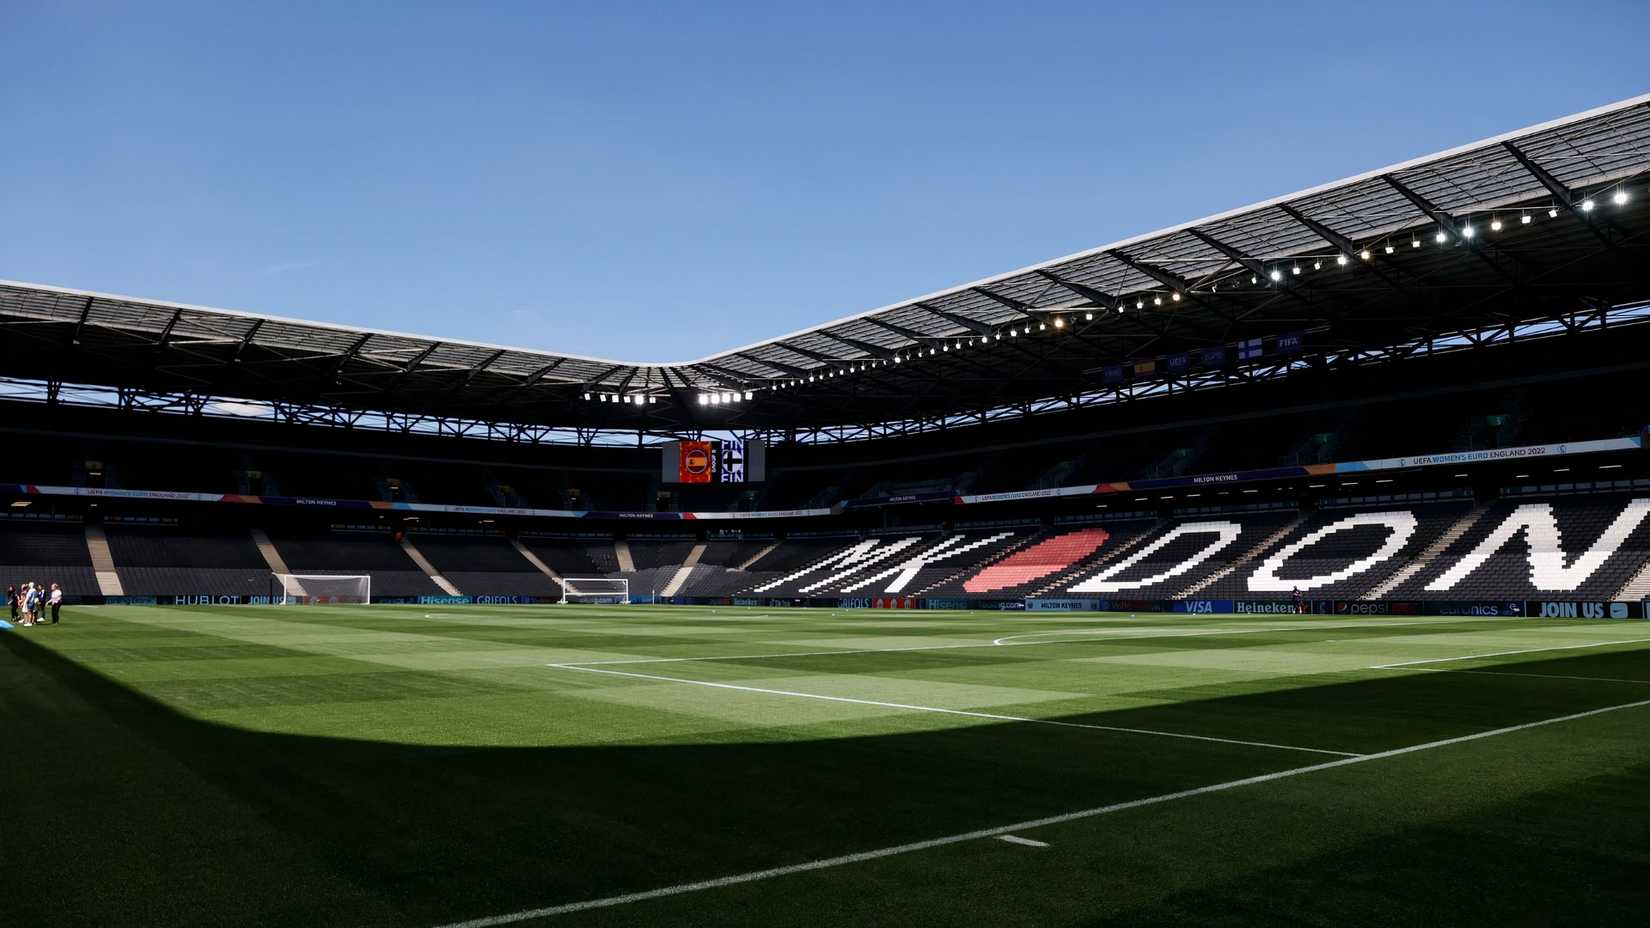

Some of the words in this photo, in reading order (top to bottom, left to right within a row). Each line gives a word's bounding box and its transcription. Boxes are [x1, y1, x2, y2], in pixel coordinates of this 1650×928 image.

[1413, 457, 1432, 466] UEFA
[1467, 452, 1489, 460] EURO
[1489, 448, 1526, 458] ENGLAND
[1527, 447, 1546, 455] 2022
[721, 473, 744, 483] FIN
[1193, 476, 1215, 484] MILTON
[1215, 474, 1238, 482] KEYNES
[753, 532, 1014, 593] MK
[175, 595, 240, 605] HUBLOT
[421, 595, 470, 604] Hisense
[476, 596, 517, 604] GRIFOLS
[838, 598, 870, 608] GRIFOLS
[1185, 601, 1213, 613] VISA
[1236, 601, 1296, 613] Heineken
[1539, 602, 1577, 618] JOIN
[1582, 602, 1604, 618] US
